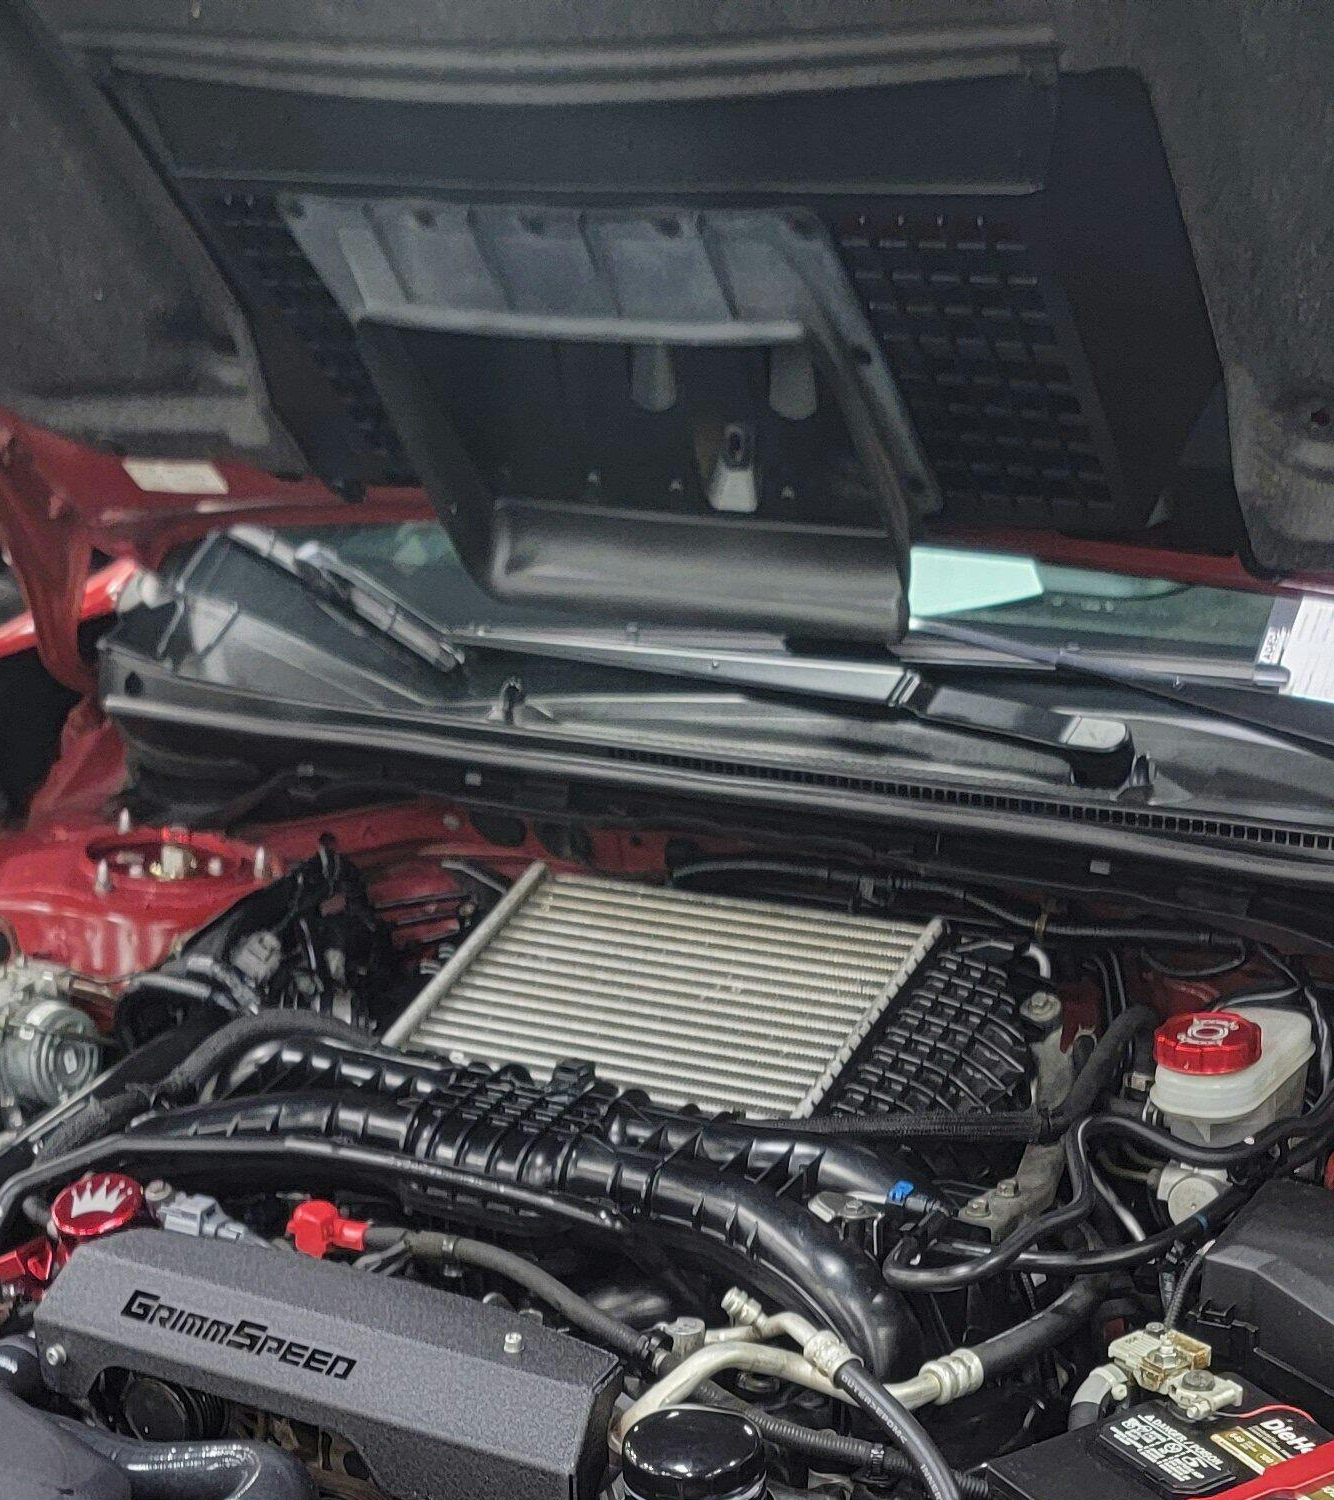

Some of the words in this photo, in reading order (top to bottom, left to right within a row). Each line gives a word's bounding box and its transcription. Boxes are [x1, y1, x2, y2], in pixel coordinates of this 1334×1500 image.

[120, 1289, 357, 1381] GRIMMSPEED
[1151, 1418, 1188, 1442] DANGER
[1259, 1418, 1317, 1454] DieH
